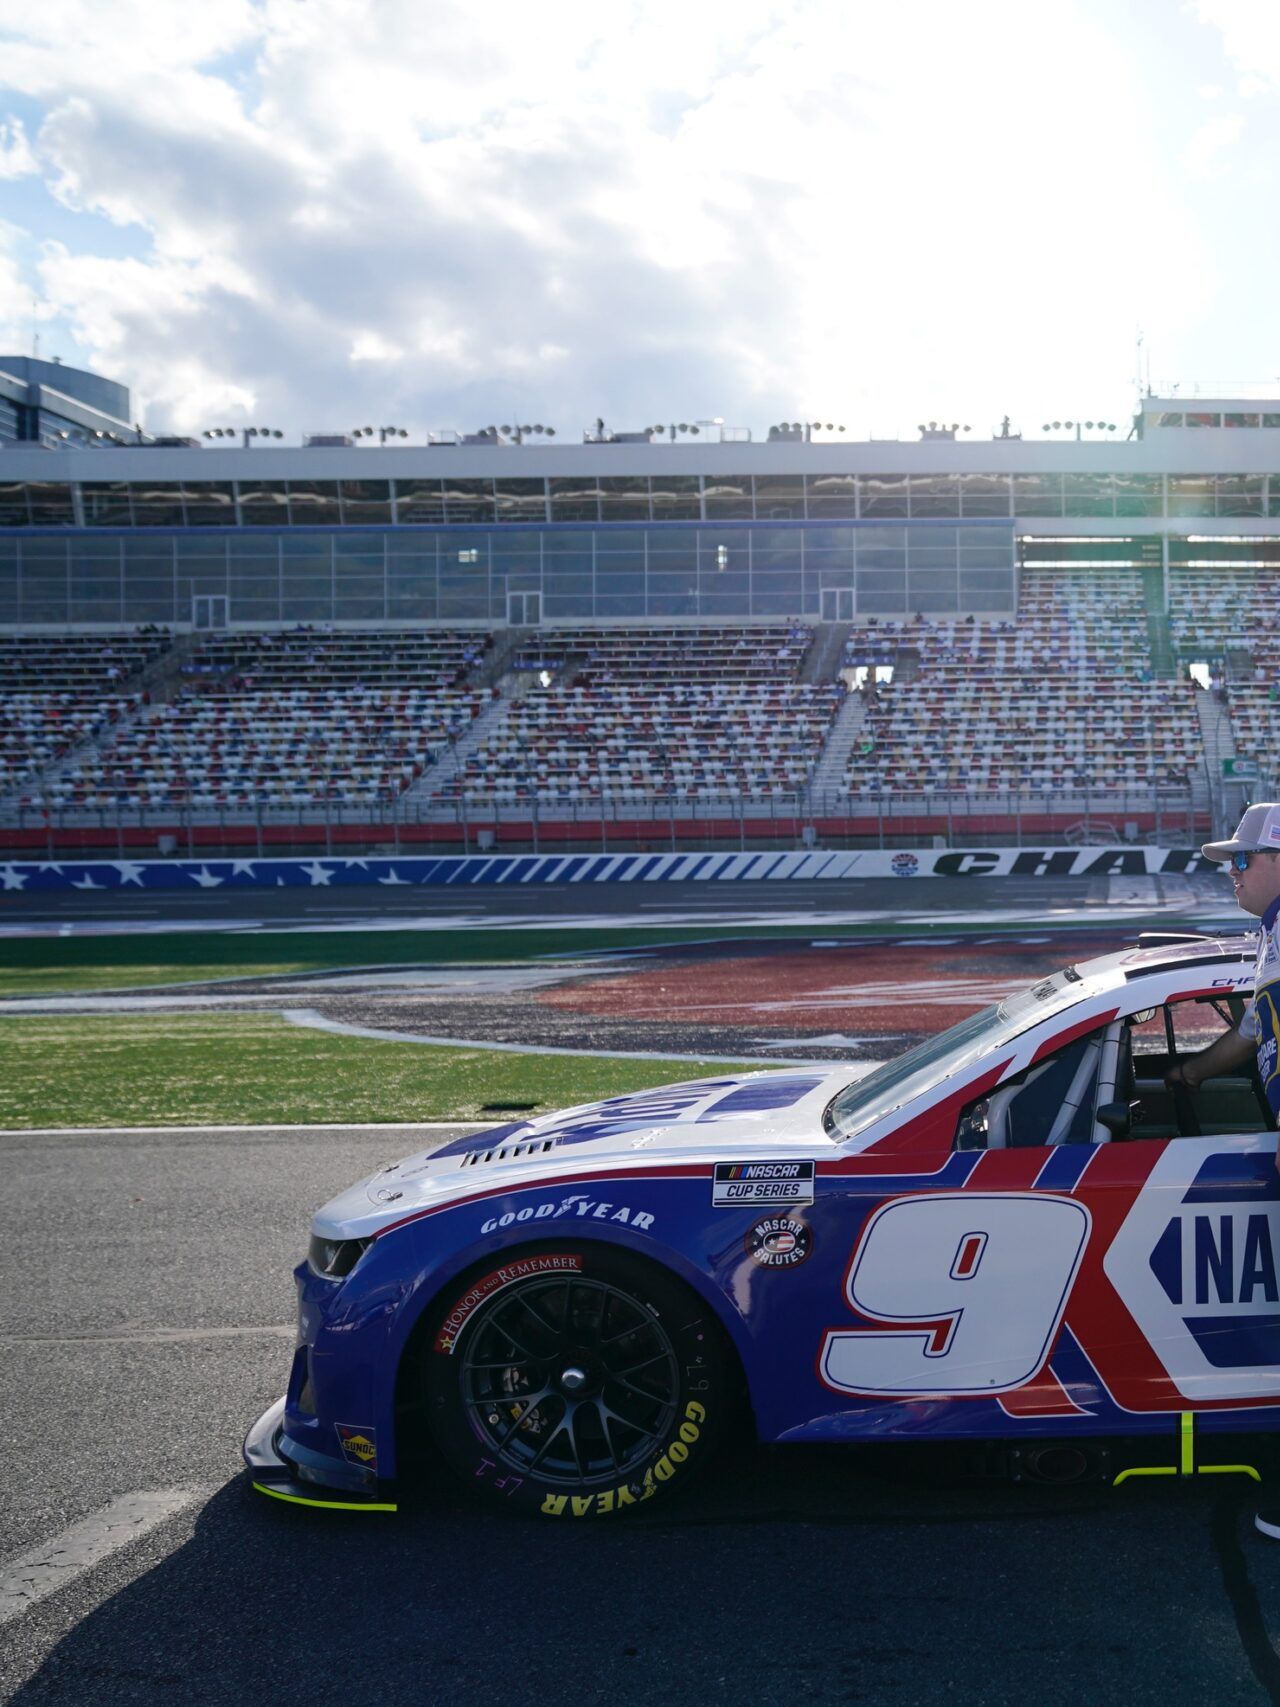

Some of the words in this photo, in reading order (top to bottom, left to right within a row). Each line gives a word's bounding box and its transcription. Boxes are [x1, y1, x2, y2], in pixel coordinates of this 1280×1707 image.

[746, 1165, 800, 1178] NASCAR
[727, 1185, 754, 1197] CUP
[754, 1183, 800, 1196] SERIES
[480, 1200, 656, 1234] GOODYEAR
[755, 1219, 804, 1237] NASCAR
[753, 1247, 805, 1265] SALUTES
[1195, 1214, 1280, 1304] NA
[442, 1289, 485, 1336] HONOR
[483, 1277, 499, 1290] AND
[497, 1256, 578, 1284] REMEMBER
[819, 1191, 1094, 1397] 9
[344, 1440, 375, 1455] SUNOC
[541, 1400, 706, 1517] GOODYEAR
